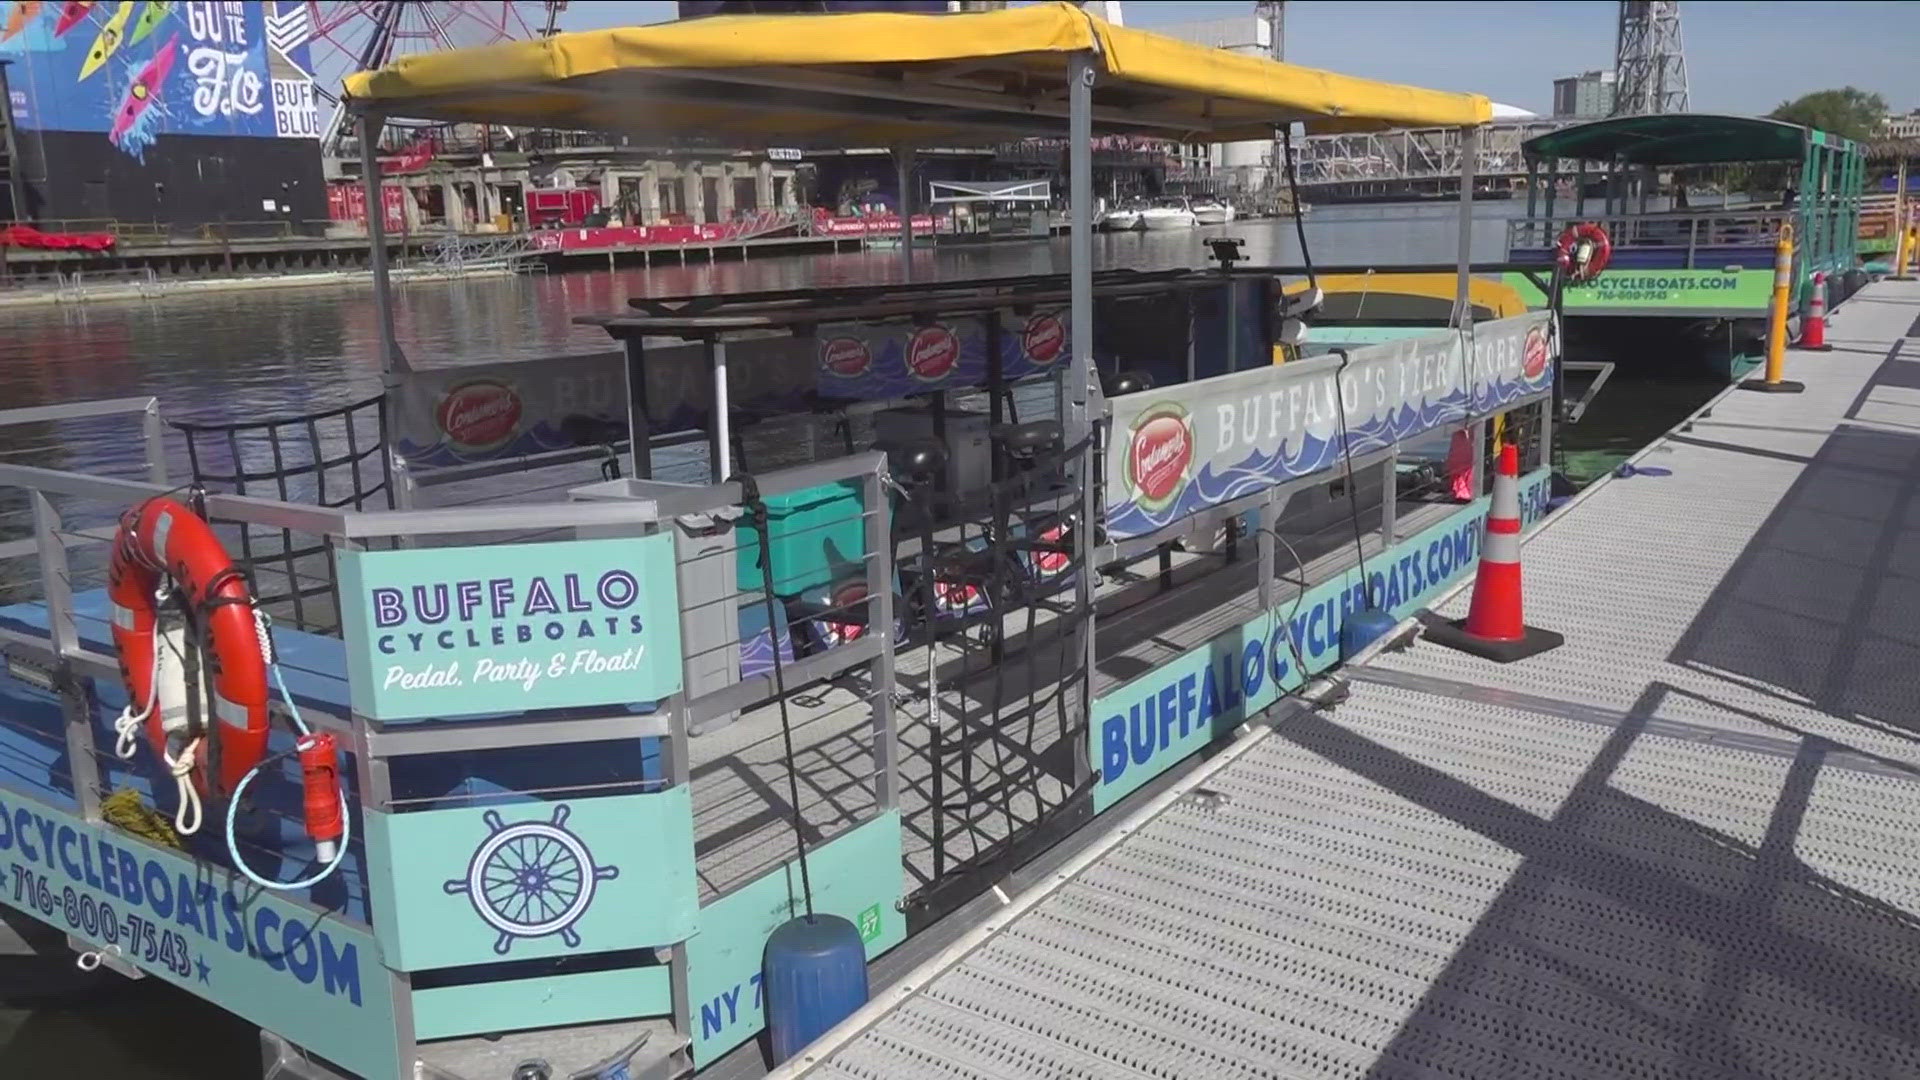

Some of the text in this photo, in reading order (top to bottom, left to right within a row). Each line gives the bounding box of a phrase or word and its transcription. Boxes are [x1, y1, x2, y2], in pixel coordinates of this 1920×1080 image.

[372, 569, 639, 628] BUFFALO
[378, 614, 644, 654] CYCLEBOATS
[473, 657, 540, 691] Party
[547, 653, 567, 678] &
[570, 645, 644, 674] Float!
[11, 863, 192, 977] 716-800-7543
[862, 916, 878, 938] 27
[701, 984, 741, 1041] NY
